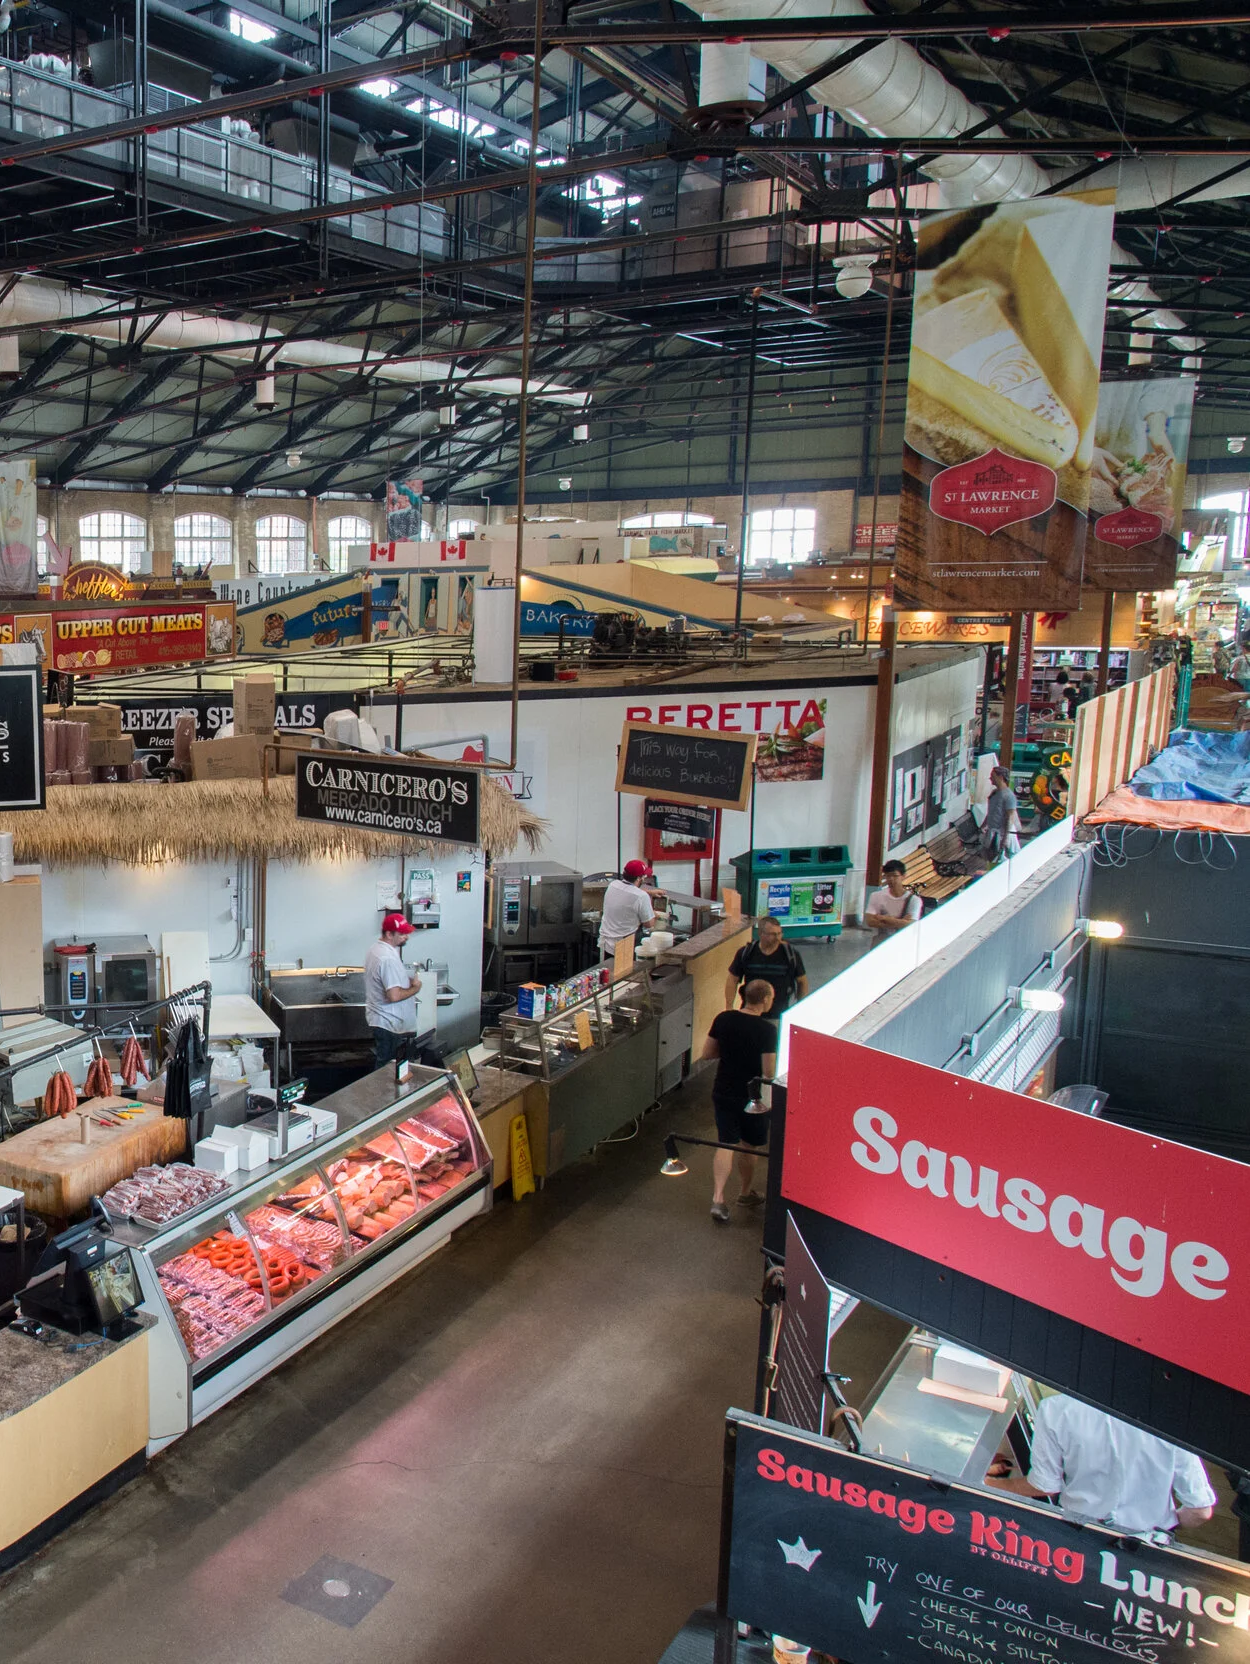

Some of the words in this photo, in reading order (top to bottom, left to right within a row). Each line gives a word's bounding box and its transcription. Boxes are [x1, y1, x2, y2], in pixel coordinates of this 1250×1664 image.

[961, 489, 1040, 502] LAWRENCE
[970, 506, 1011, 514] MARKET
[932, 568, 1040, 578] stlawrencemarket.com
[220, 583, 250, 605] Wine
[57, 618, 115, 640] UPPER
[116, 616, 149, 636] CUT
[151, 613, 203, 633] MEATS
[526, 609, 594, 629] BAKERY
[867, 621, 989, 637] PLCEWARES
[115, 650, 138, 660] RETAIL
[626, 699, 826, 732] BERETTA
[306, 761, 469, 805] CARNICERO'S
[317, 788, 391, 814] MERCADO
[397, 801, 453, 822] LUNCH
[325, 806, 442, 835] www.carnicero's.ca
[770, 885, 790, 893] Recycle
[851, 1106, 1230, 1300] Sausage
[756, 1448, 955, 1534] Sausage
[969, 1511, 1085, 1584] King
[970, 1545, 986, 1556] BY
[991, 1551, 1048, 1577] OLLIFFE
[865, 1555, 898, 1583] TRY
[916, 1572, 954, 1592] ONE
[963, 1587, 986, 1599] OF
[995, 1598, 1033, 1620] OUR
[1046, 1614, 1158, 1661] DELICIOUS
[921, 1597, 981, 1624] CHEESE
[1004, 1622, 1059, 1649] ONION
[921, 1614, 984, 1647] STEAK
